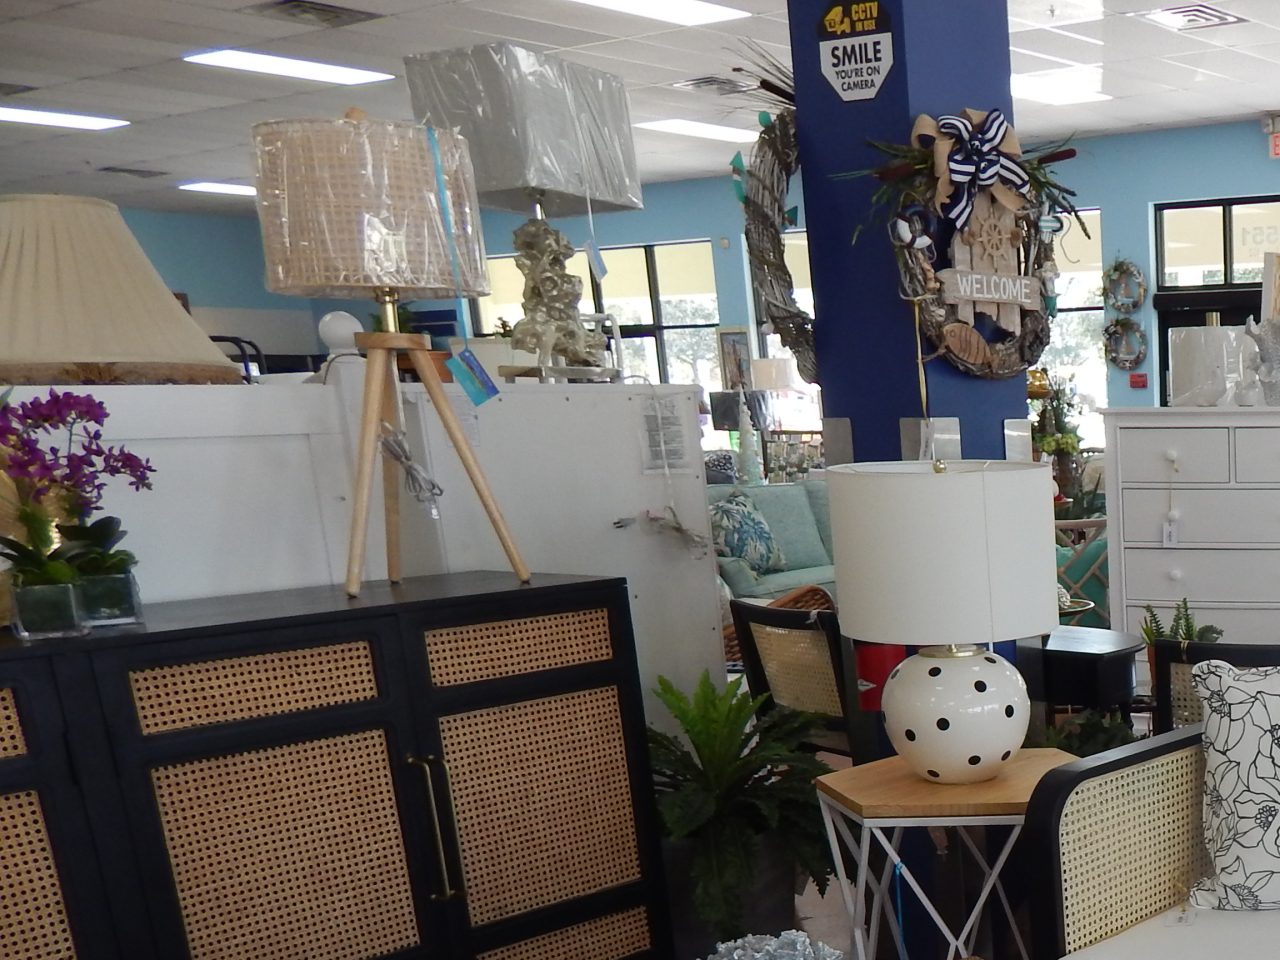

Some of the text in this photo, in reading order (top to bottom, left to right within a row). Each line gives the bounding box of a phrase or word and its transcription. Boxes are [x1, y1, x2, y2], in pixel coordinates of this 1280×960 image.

[851, 2, 878, 20] CCTV
[831, 41, 882, 68] SMILE
[835, 65, 880, 80] YOU'RE ON
[841, 78, 876, 91] CAMERA
[957, 273, 1032, 303] WELCOME
